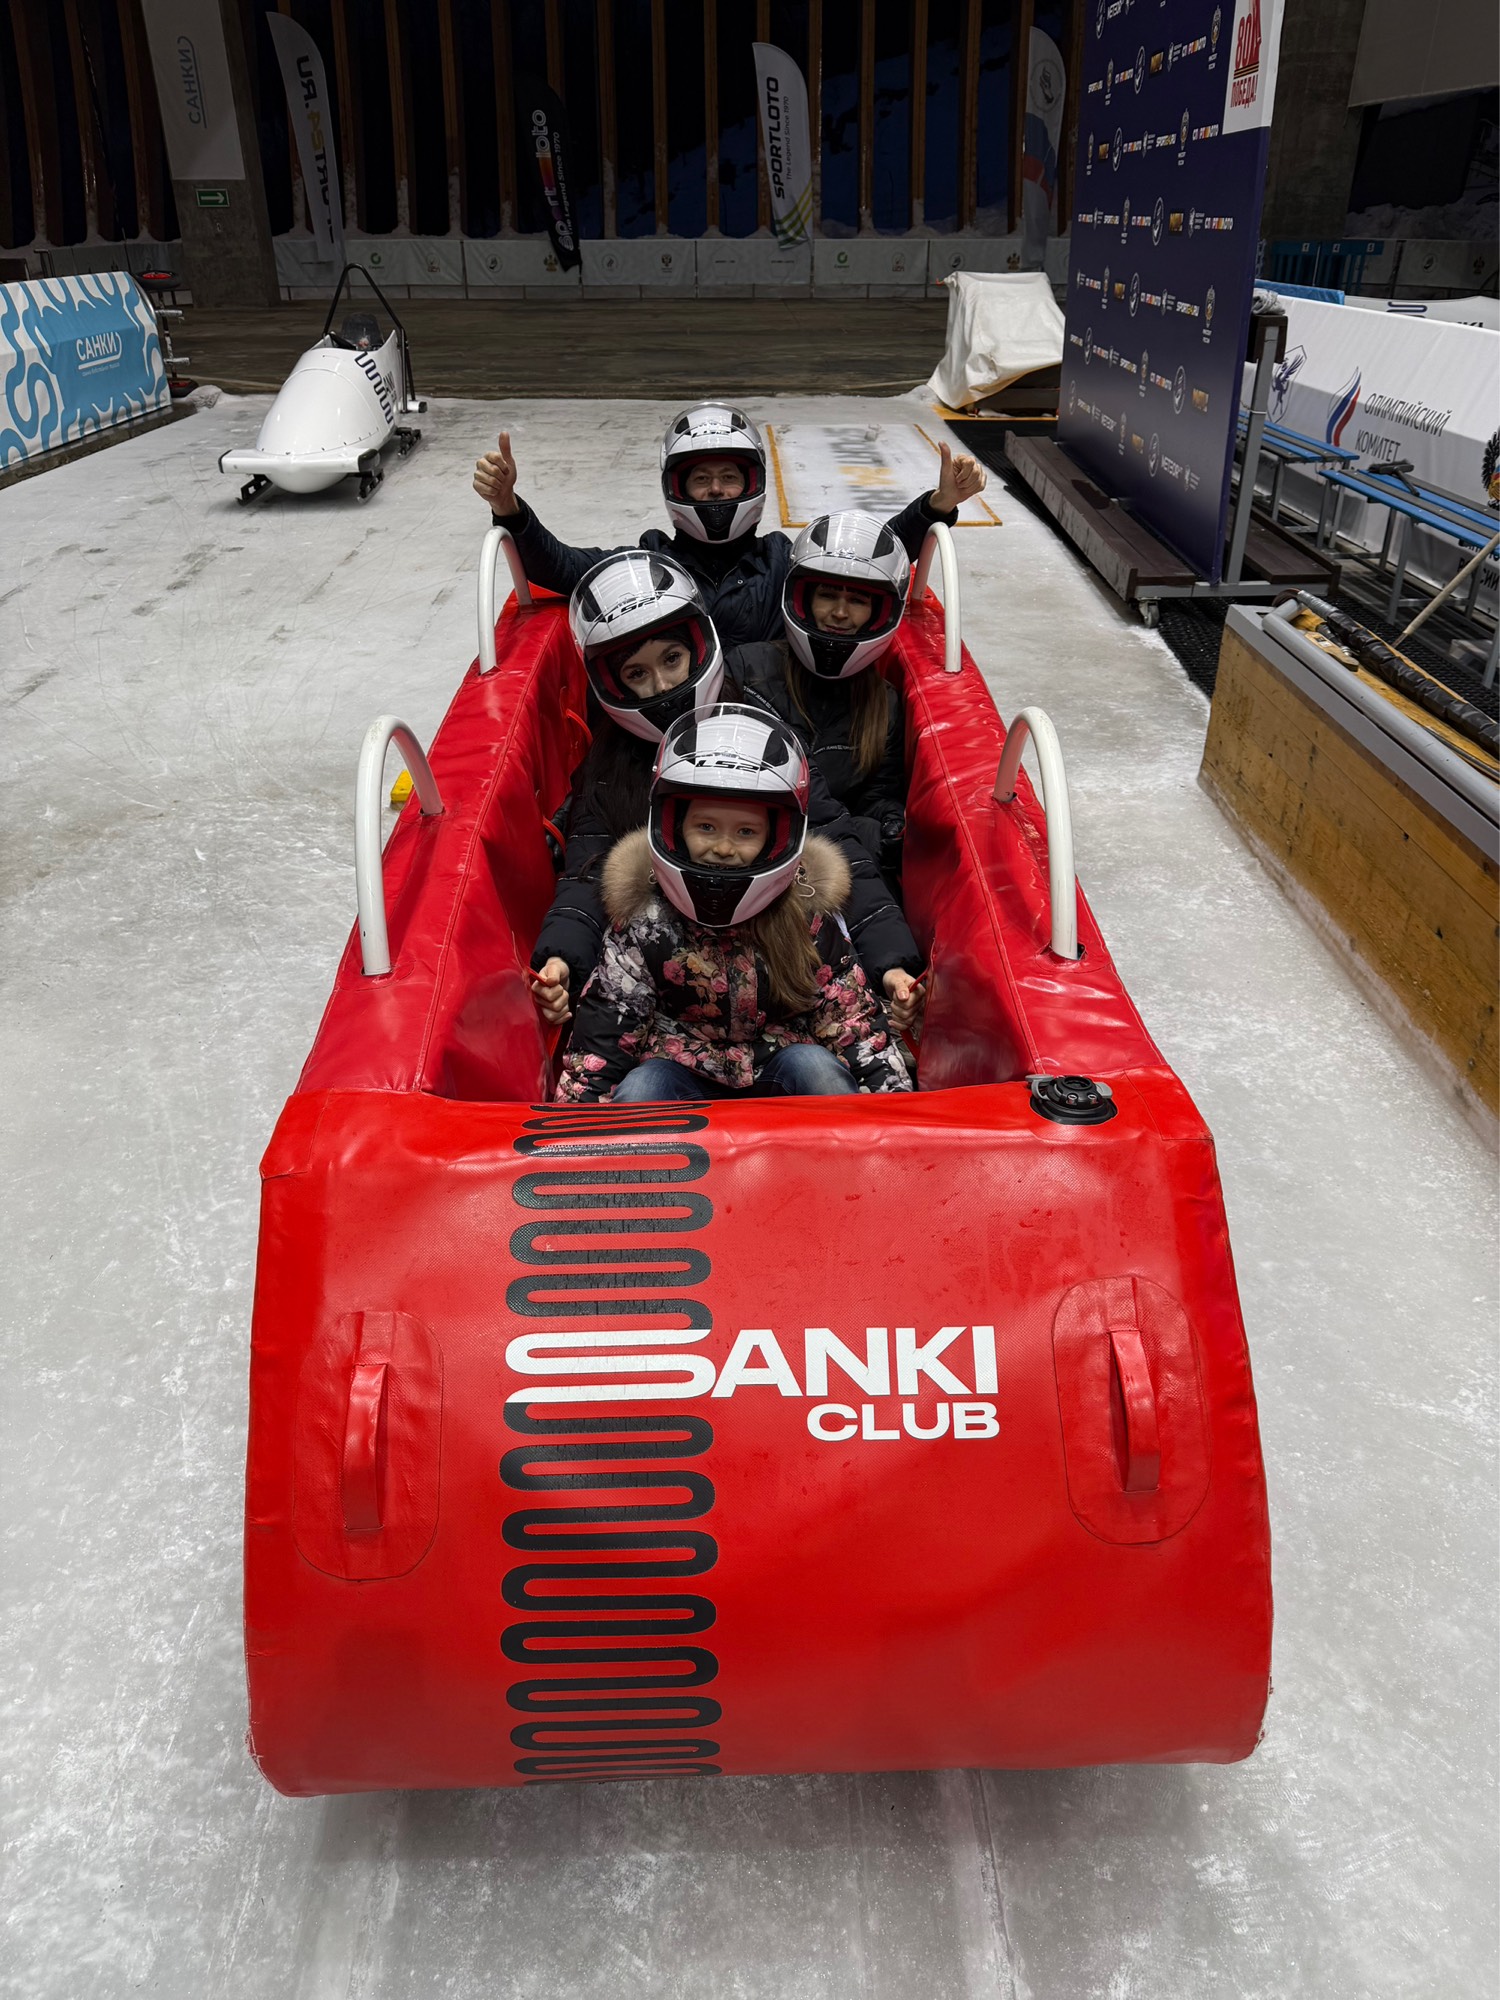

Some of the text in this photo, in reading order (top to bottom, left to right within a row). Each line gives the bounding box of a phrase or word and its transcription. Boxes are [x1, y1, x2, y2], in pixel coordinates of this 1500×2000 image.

[1236, 16, 1251, 70] 80
[179, 49, 201, 126] САНКИ
[1230, 74, 1258, 108] ПОБЕДА!
[766, 76, 785, 200] SPORTLOTO
[556, 155, 565, 182] Since
[559, 183, 570, 217] Legend
[76, 332, 117, 361] САНКИ
[1364, 393, 1452, 437] ОЛИМПИЙСКИЙ
[1355, 429, 1401, 463] КОМИТЕТ
[607, 596, 655, 623] LS2
[695, 759, 760, 773] LS2
[505, 1325, 999, 1403] SANKI
[806, 1402, 1000, 1440] CLUB
